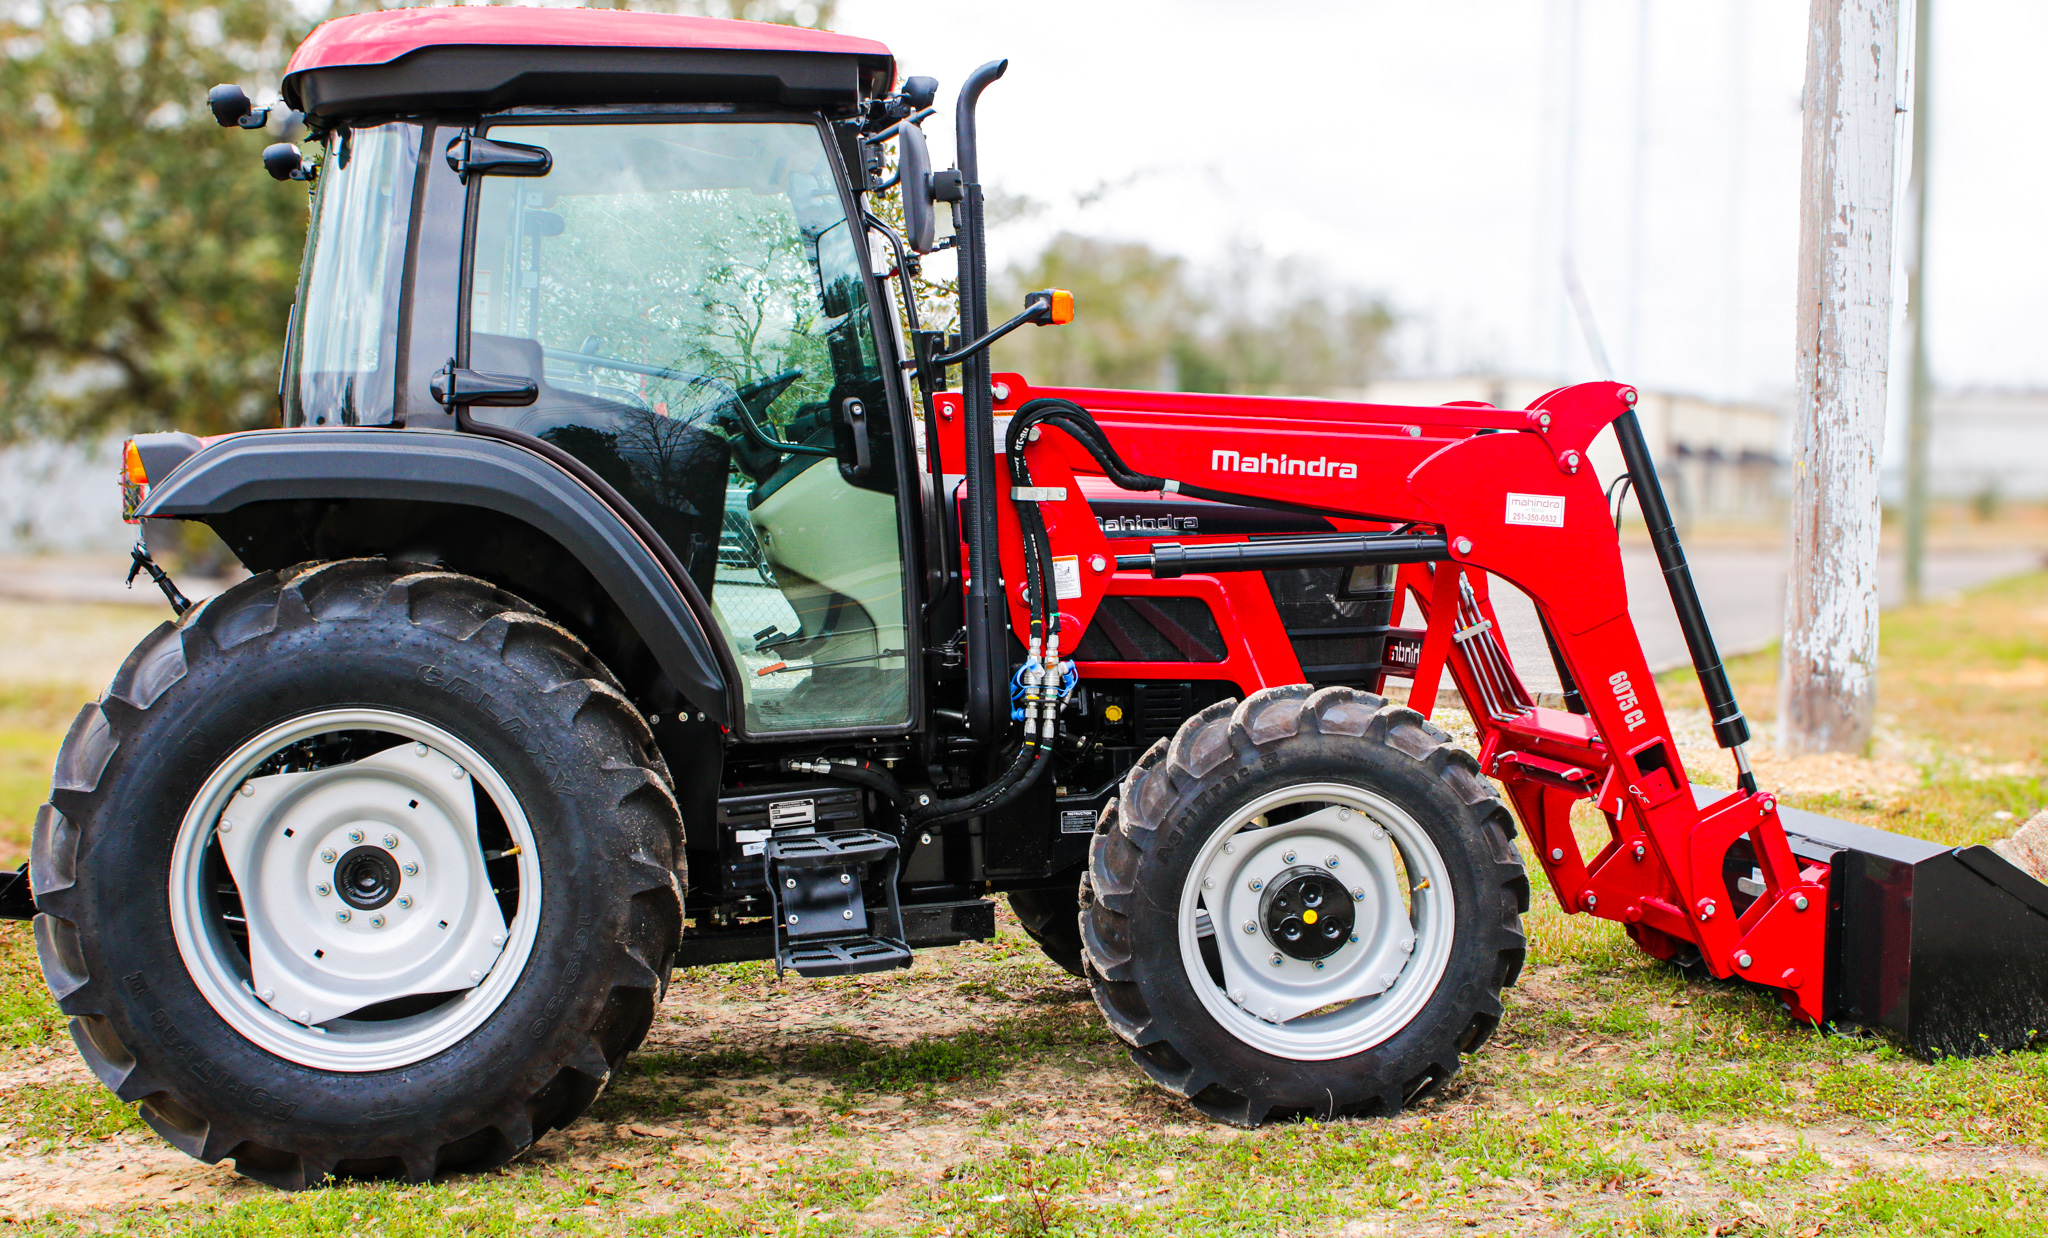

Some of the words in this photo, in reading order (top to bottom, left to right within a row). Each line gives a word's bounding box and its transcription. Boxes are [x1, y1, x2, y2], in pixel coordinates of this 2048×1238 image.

[1512, 512, 1557, 522] 251-350-0532
[416, 664, 576, 797] GALAXY
[1608, 670, 1639, 711] 6075
[1624, 708, 1647, 732] CL
[530, 914, 592, 1039] 16.9-30
